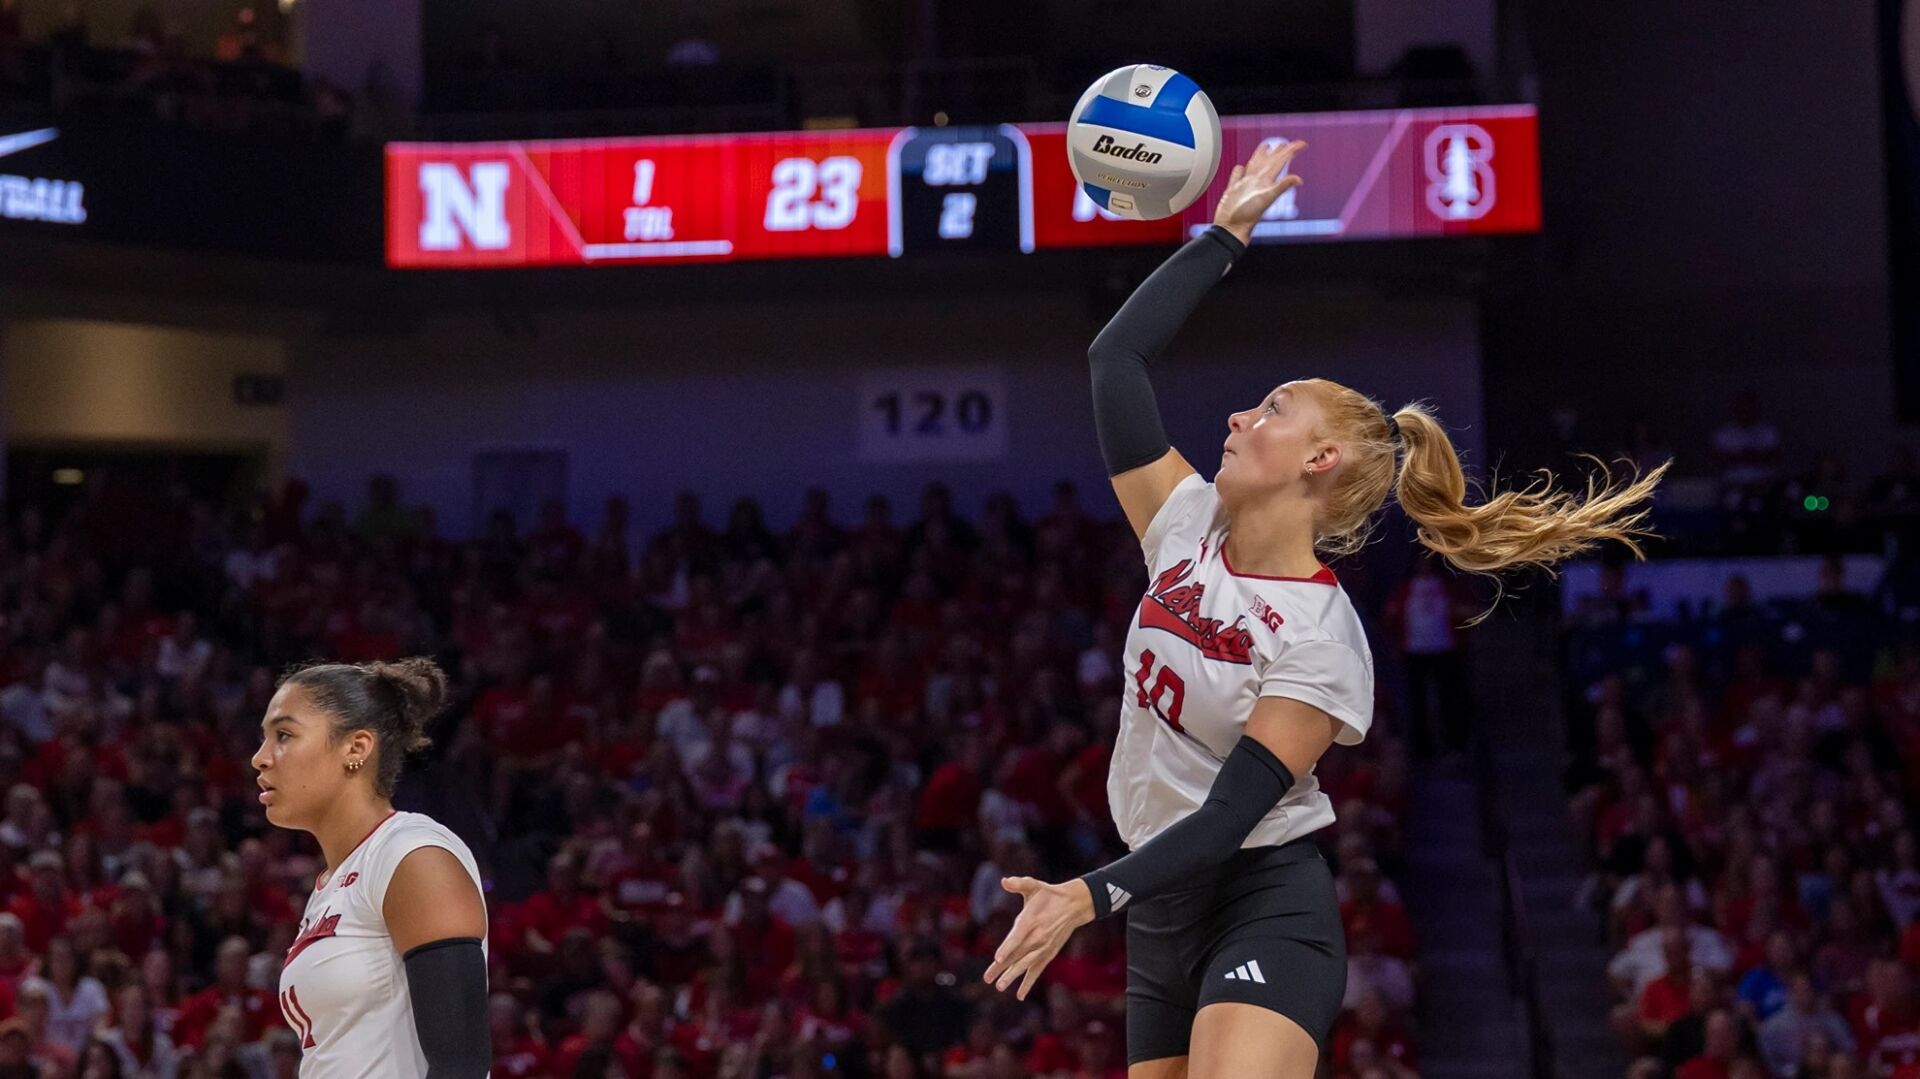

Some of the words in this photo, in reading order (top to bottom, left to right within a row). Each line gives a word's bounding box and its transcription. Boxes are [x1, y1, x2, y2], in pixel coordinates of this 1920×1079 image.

[923, 142, 995, 186] SET
[1092, 134, 1162, 164] Baden
[633, 159, 656, 205] 1
[764, 156, 862, 231] 23
[418, 161, 511, 252] N
[939, 193, 977, 239] 2
[873, 390, 993, 435] 120
[1135, 648, 1185, 734] 10
